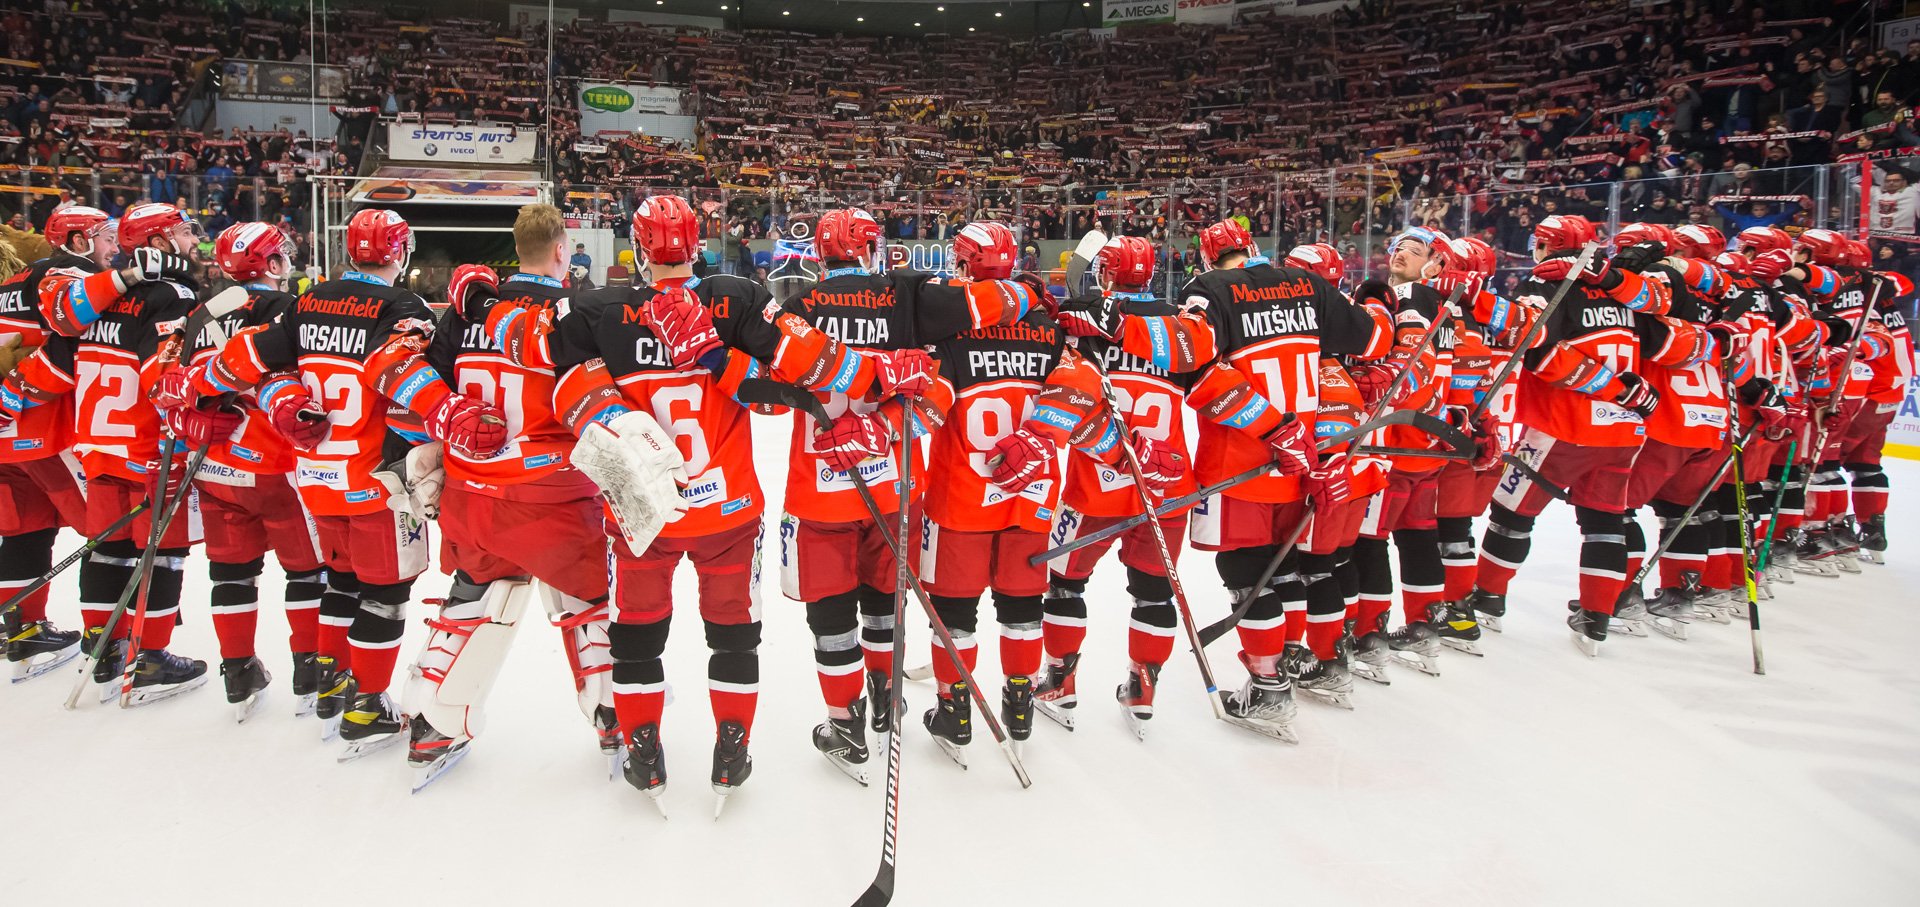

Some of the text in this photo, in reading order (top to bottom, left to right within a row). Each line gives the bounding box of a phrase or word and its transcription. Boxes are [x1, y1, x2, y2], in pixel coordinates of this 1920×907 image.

[1125, 4, 1169, 18] MEGAS
[1891, 27, 1909, 38] Fa
[587, 92, 630, 106] TEXIM
[411, 130, 516, 143] STRATOS AUTO
[359, 239, 369, 248] 32
[831, 268, 855, 277] Tipsport
[297, 293, 384, 319] Mountfield
[299, 323, 367, 355] ORSAVA
[674, 327, 719, 358] CCM
[1151, 321, 1166, 357] Tipsport
[1176, 330, 1193, 364] Bohemia
[803, 358, 826, 387] Bohemia
[835, 353, 859, 390] Tipsport
[968, 350, 1052, 377] PERRET
[75, 360, 140, 437] 72
[1211, 388, 1239, 415] Bohemia
[1317, 403, 1349, 413] Bohemia
[1727, 381, 1741, 439] CCM
[651, 383, 711, 477] 6
[1069, 422, 1096, 445] Bohemia
[1015, 428, 1055, 461] CCM
[884, 732, 901, 867] WARRIOR
